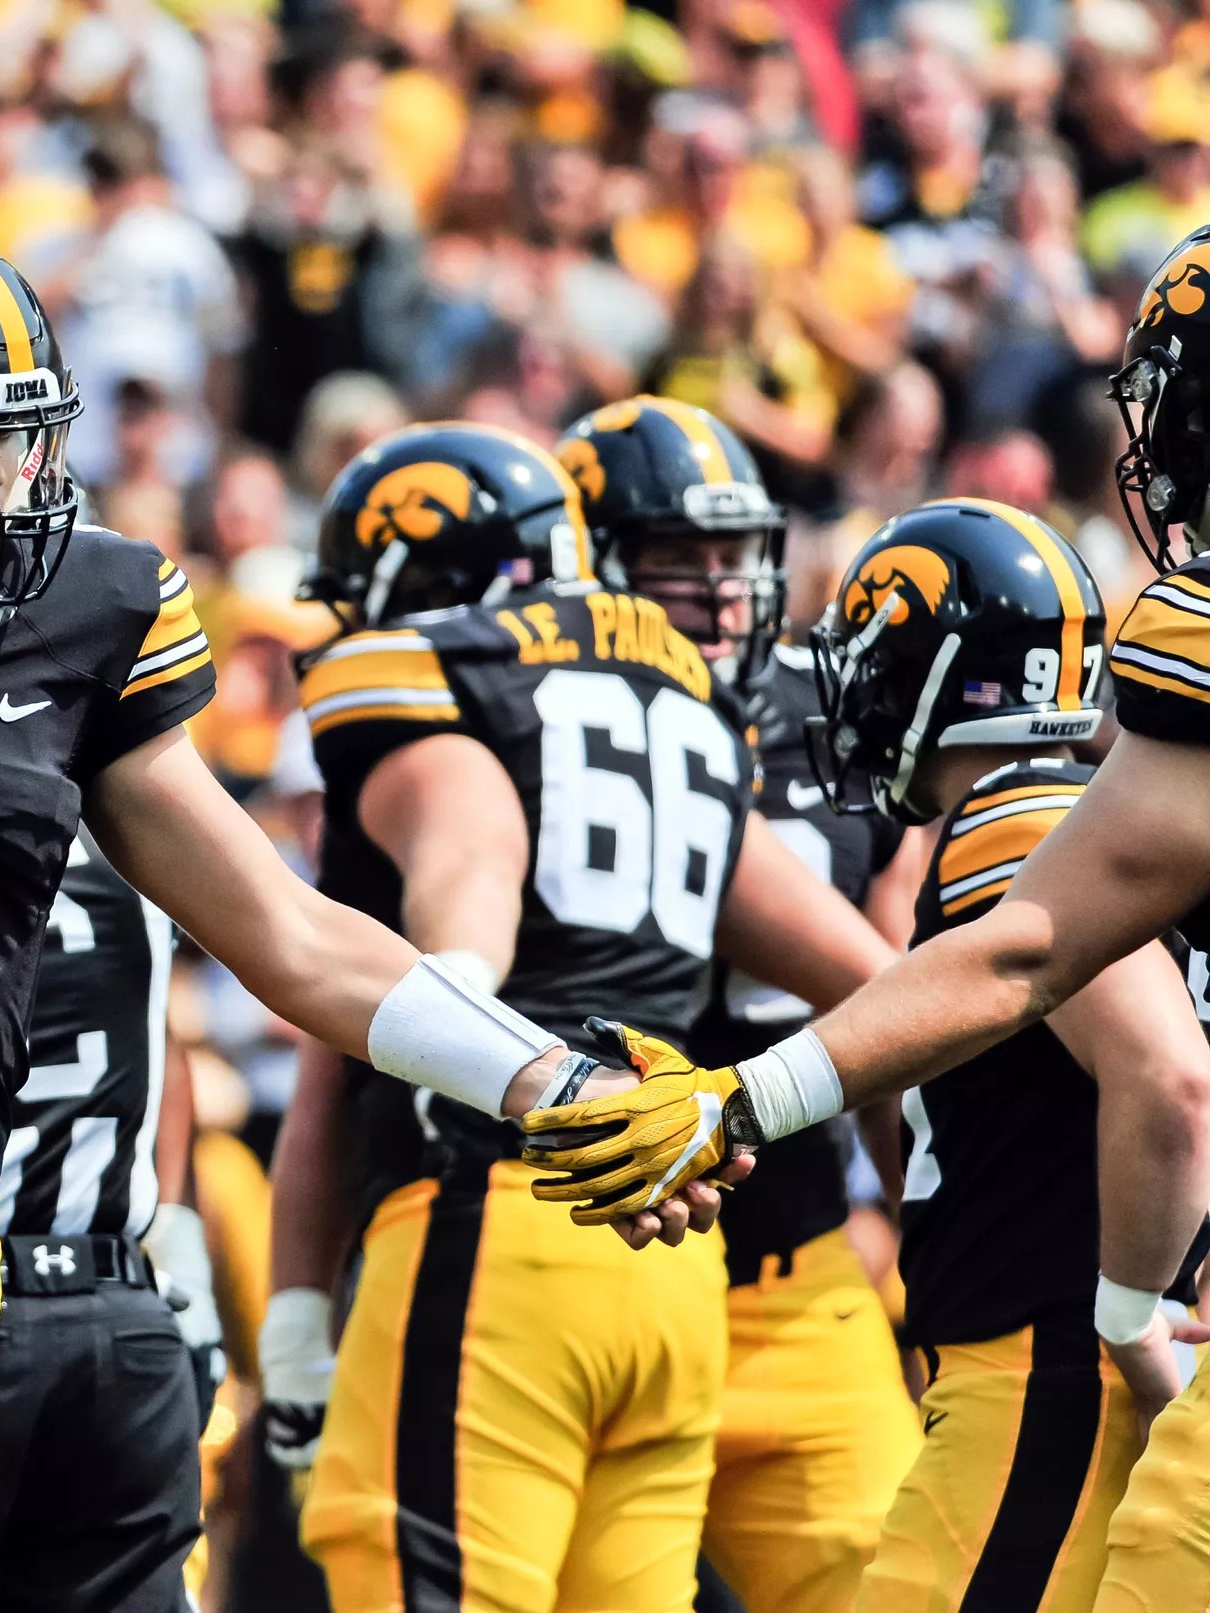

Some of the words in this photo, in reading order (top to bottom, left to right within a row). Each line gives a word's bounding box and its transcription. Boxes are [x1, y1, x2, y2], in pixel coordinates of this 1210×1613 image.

[5, 378, 49, 403] IOWA
[21, 443, 44, 481] Ridd
[1022, 644, 1103, 702] 97
[532, 669, 738, 960] 66
